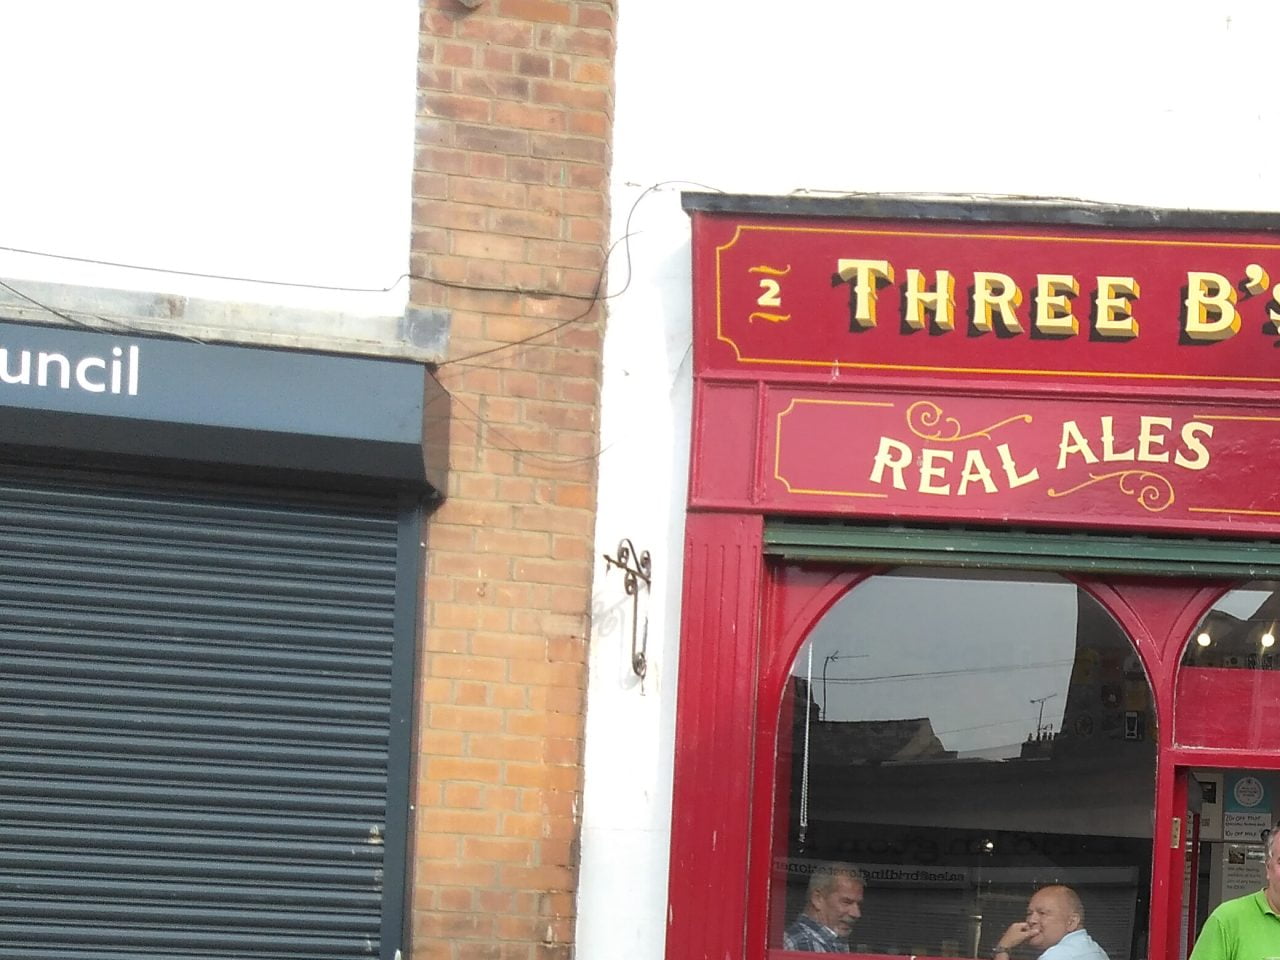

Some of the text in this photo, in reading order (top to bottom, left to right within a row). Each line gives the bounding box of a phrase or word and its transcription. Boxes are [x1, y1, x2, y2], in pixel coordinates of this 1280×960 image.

[757, 279, 781, 307] 2
[832, 258, 1141, 342] THREE
[0, 345, 139, 396] uncil
[869, 416, 1214, 496] REAL ALES
